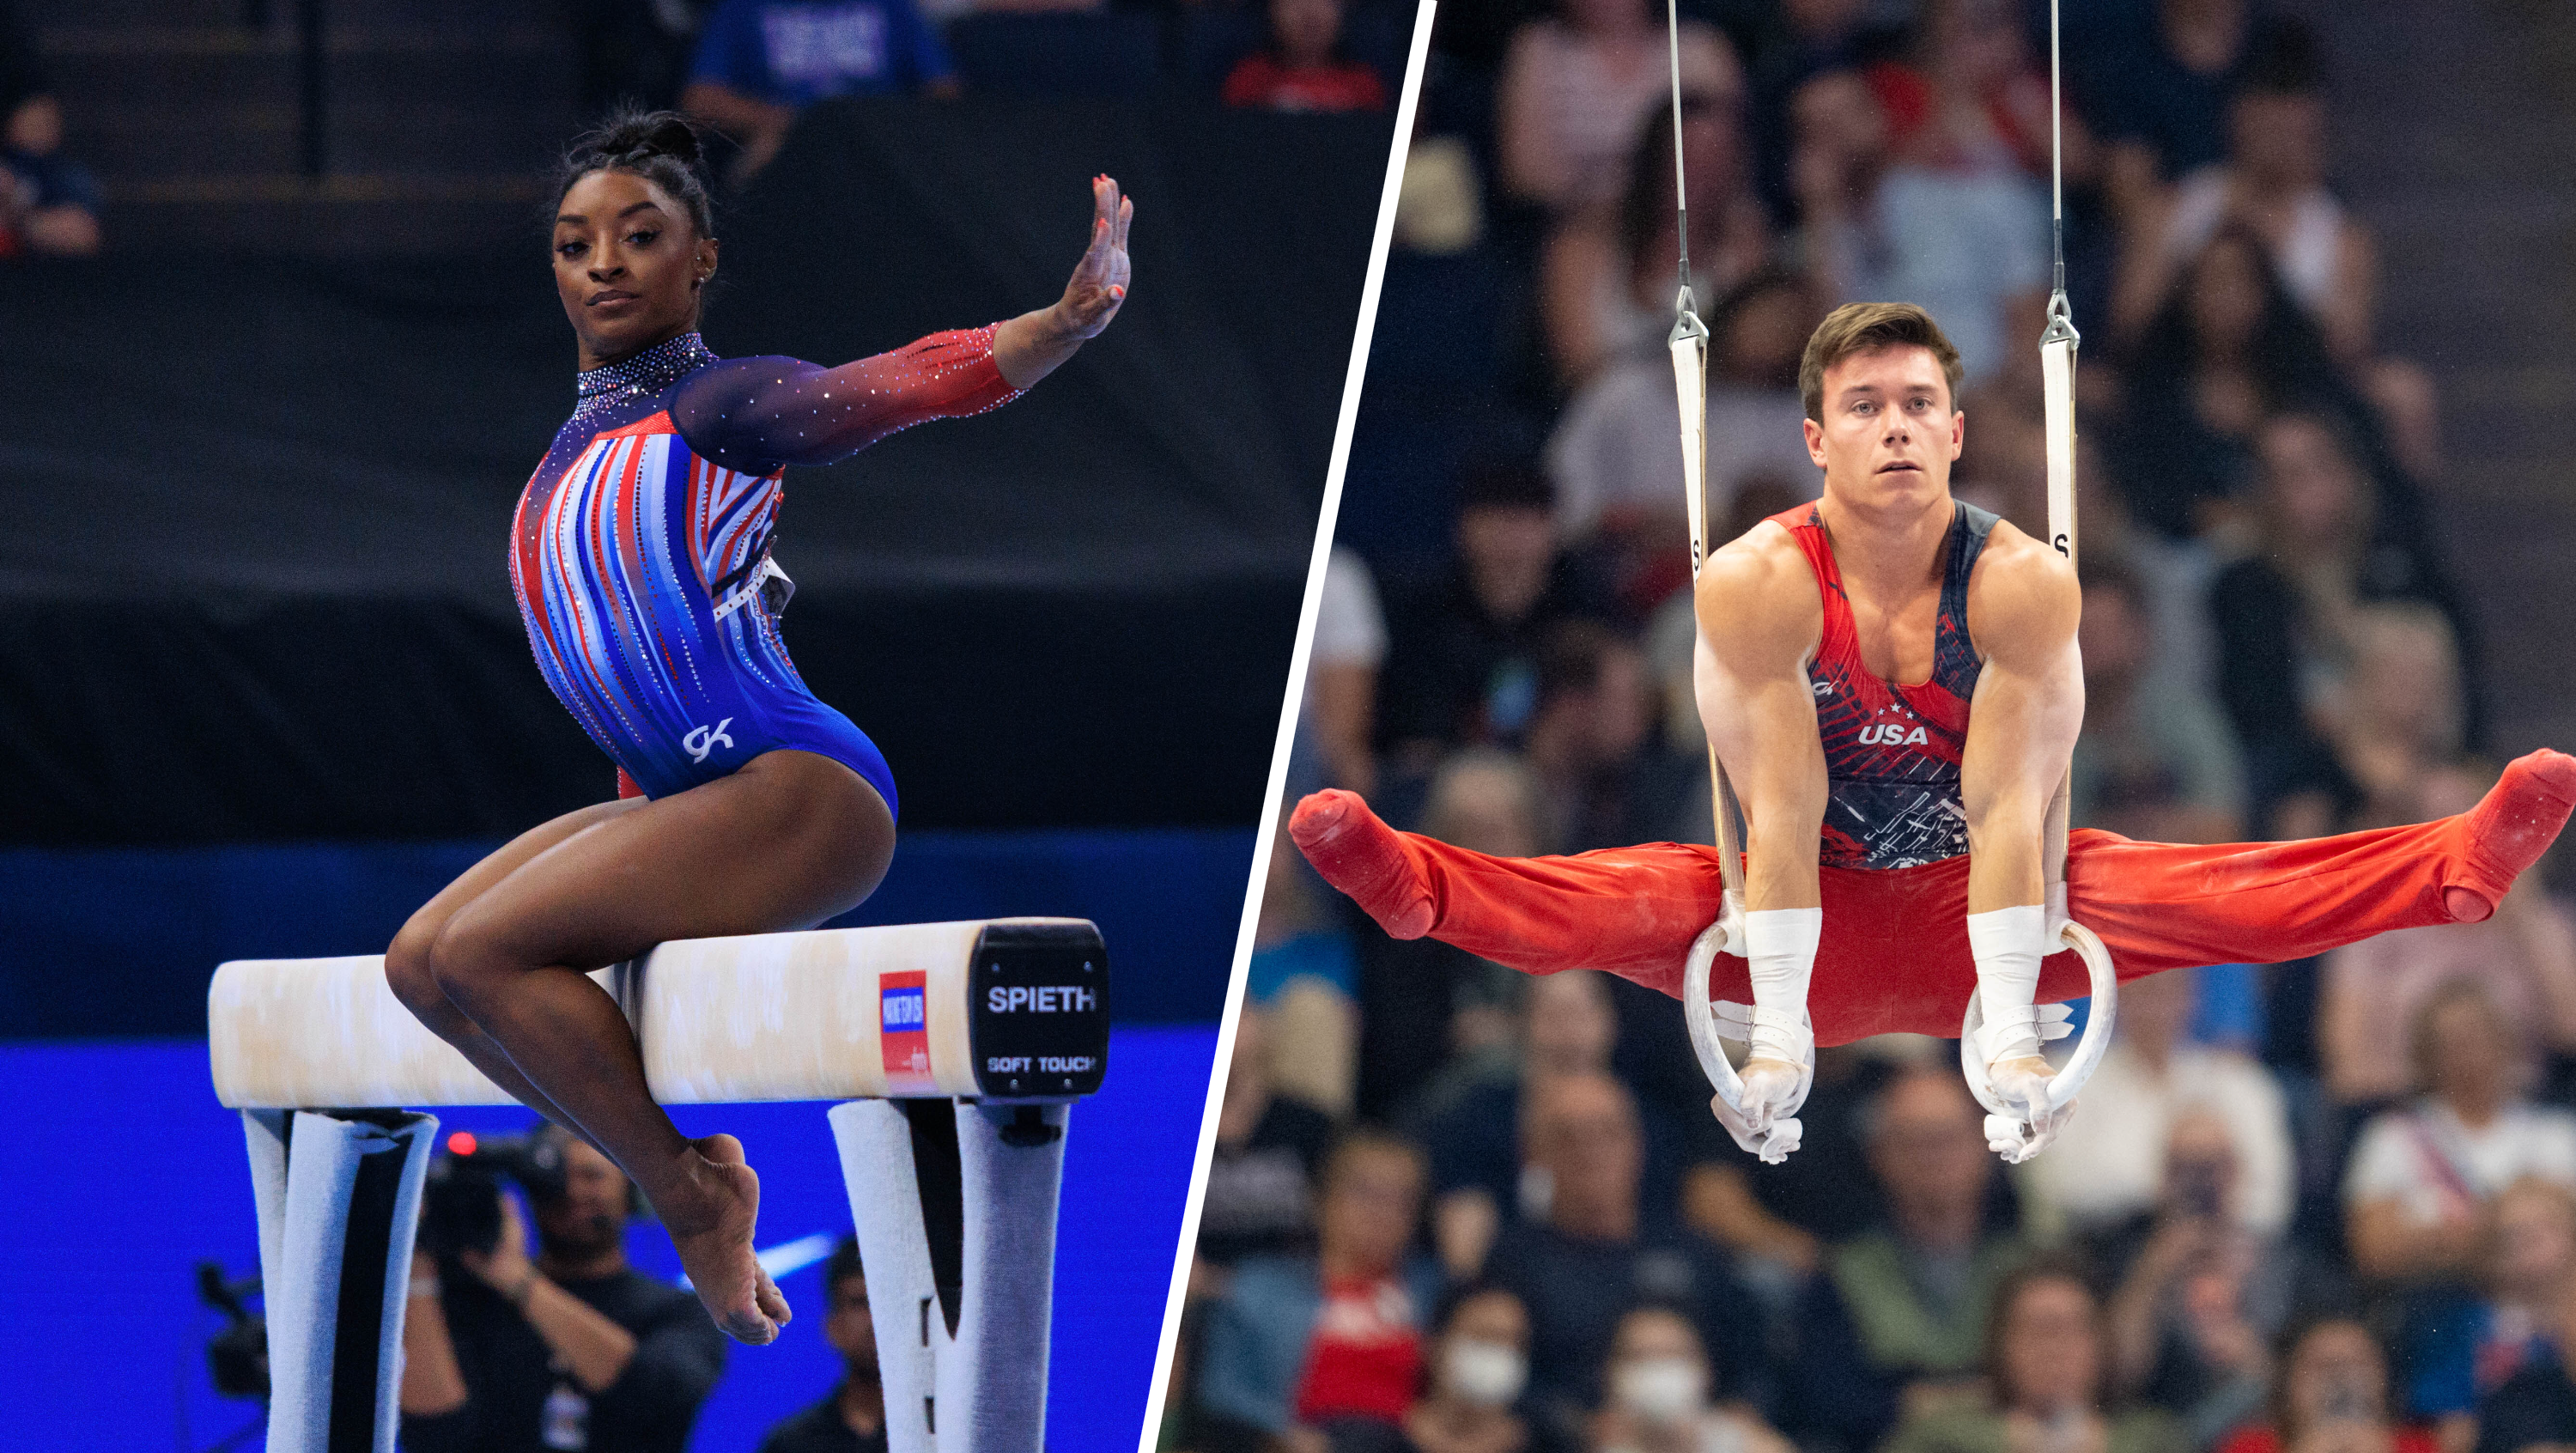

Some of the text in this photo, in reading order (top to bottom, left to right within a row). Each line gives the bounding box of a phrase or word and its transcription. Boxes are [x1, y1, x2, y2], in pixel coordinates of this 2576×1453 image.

[1858, 724, 1929, 745] USA
[987, 986, 1097, 1013] SPIETH
[987, 1056, 1097, 1073] SOFT TOUCH
